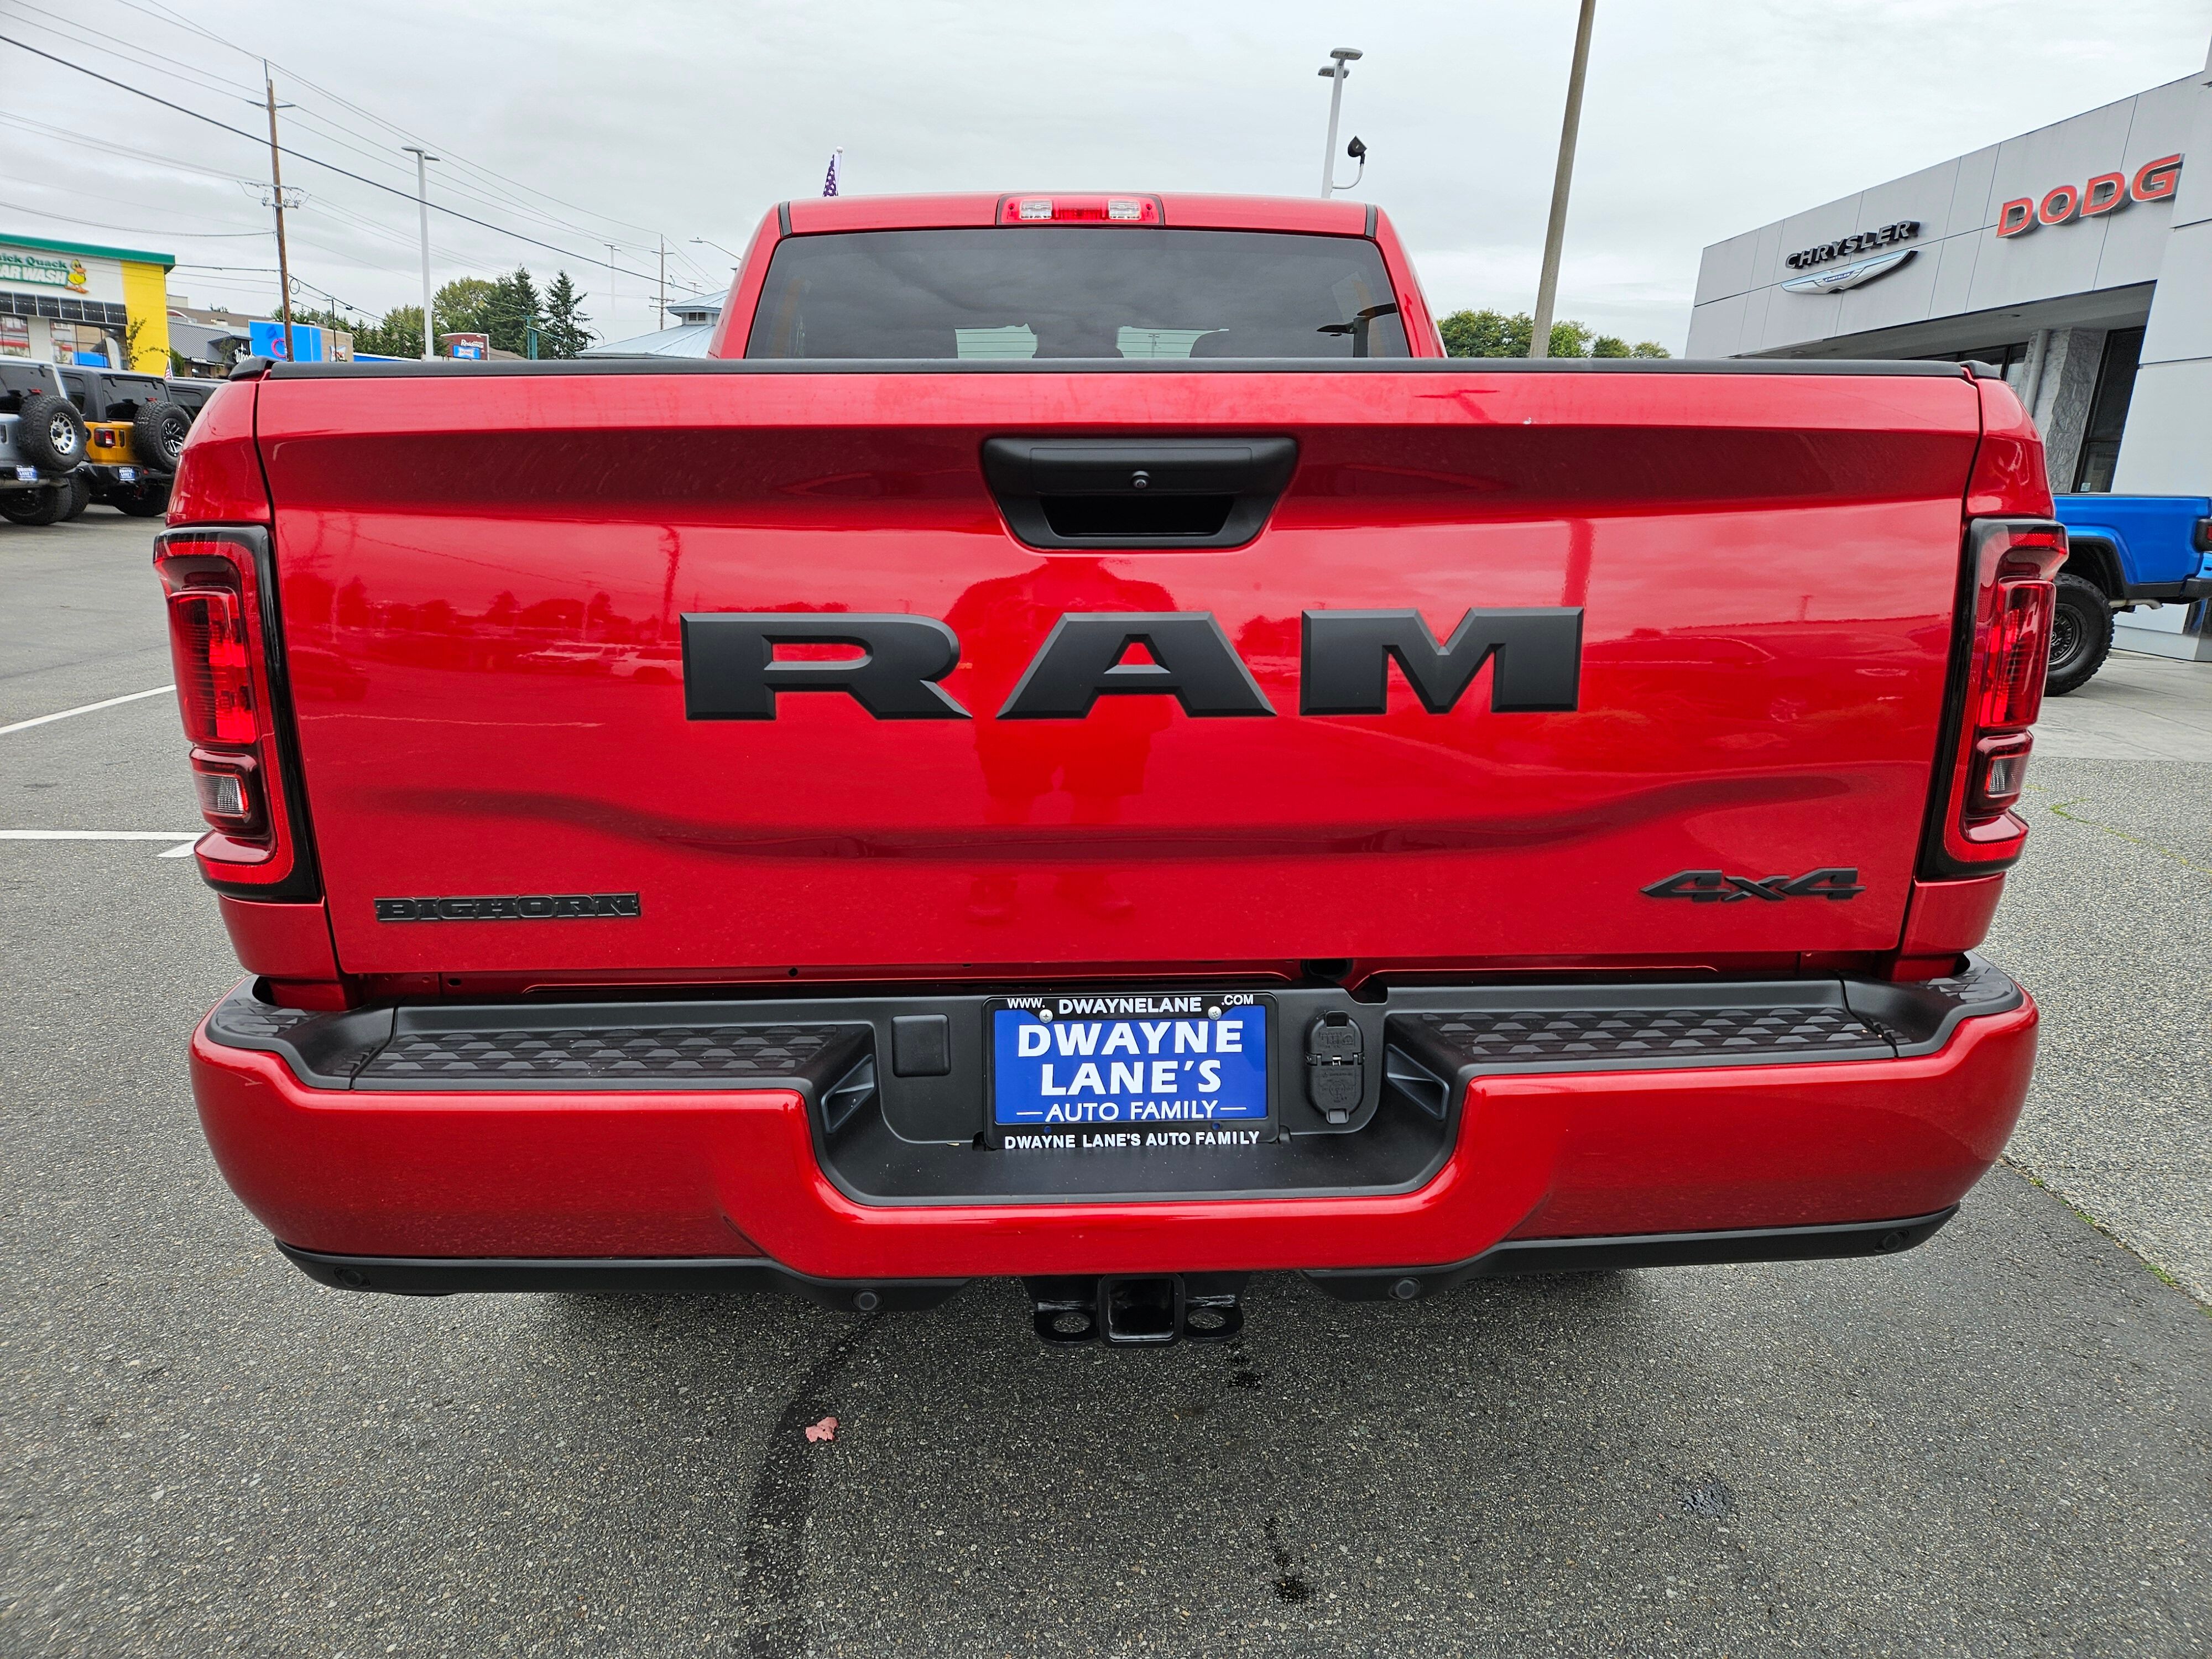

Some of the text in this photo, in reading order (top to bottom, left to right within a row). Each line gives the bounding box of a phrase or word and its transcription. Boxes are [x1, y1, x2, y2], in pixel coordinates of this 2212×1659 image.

[1785, 221, 1914, 269] CHRYSLER
[0, 253, 67, 269] ick Quack
[0, 264, 66, 284] AR WASH
[1825, 273, 1851, 281] CHRYSLER
[680, 607, 1584, 720] RAM
[373, 891, 641, 922] BIGHORN
[1007, 994, 1254, 1014] WWW. DWAYNELANE .COM
[1018, 1021, 1243, 1057] DWAYNE
[1041, 1060, 1221, 1095] LANE'S
[1045, 1100, 1218, 1122] AUTO FAMILY
[1005, 1131, 1260, 1149] DWAYNE LANE'S AUTO FAMILY
